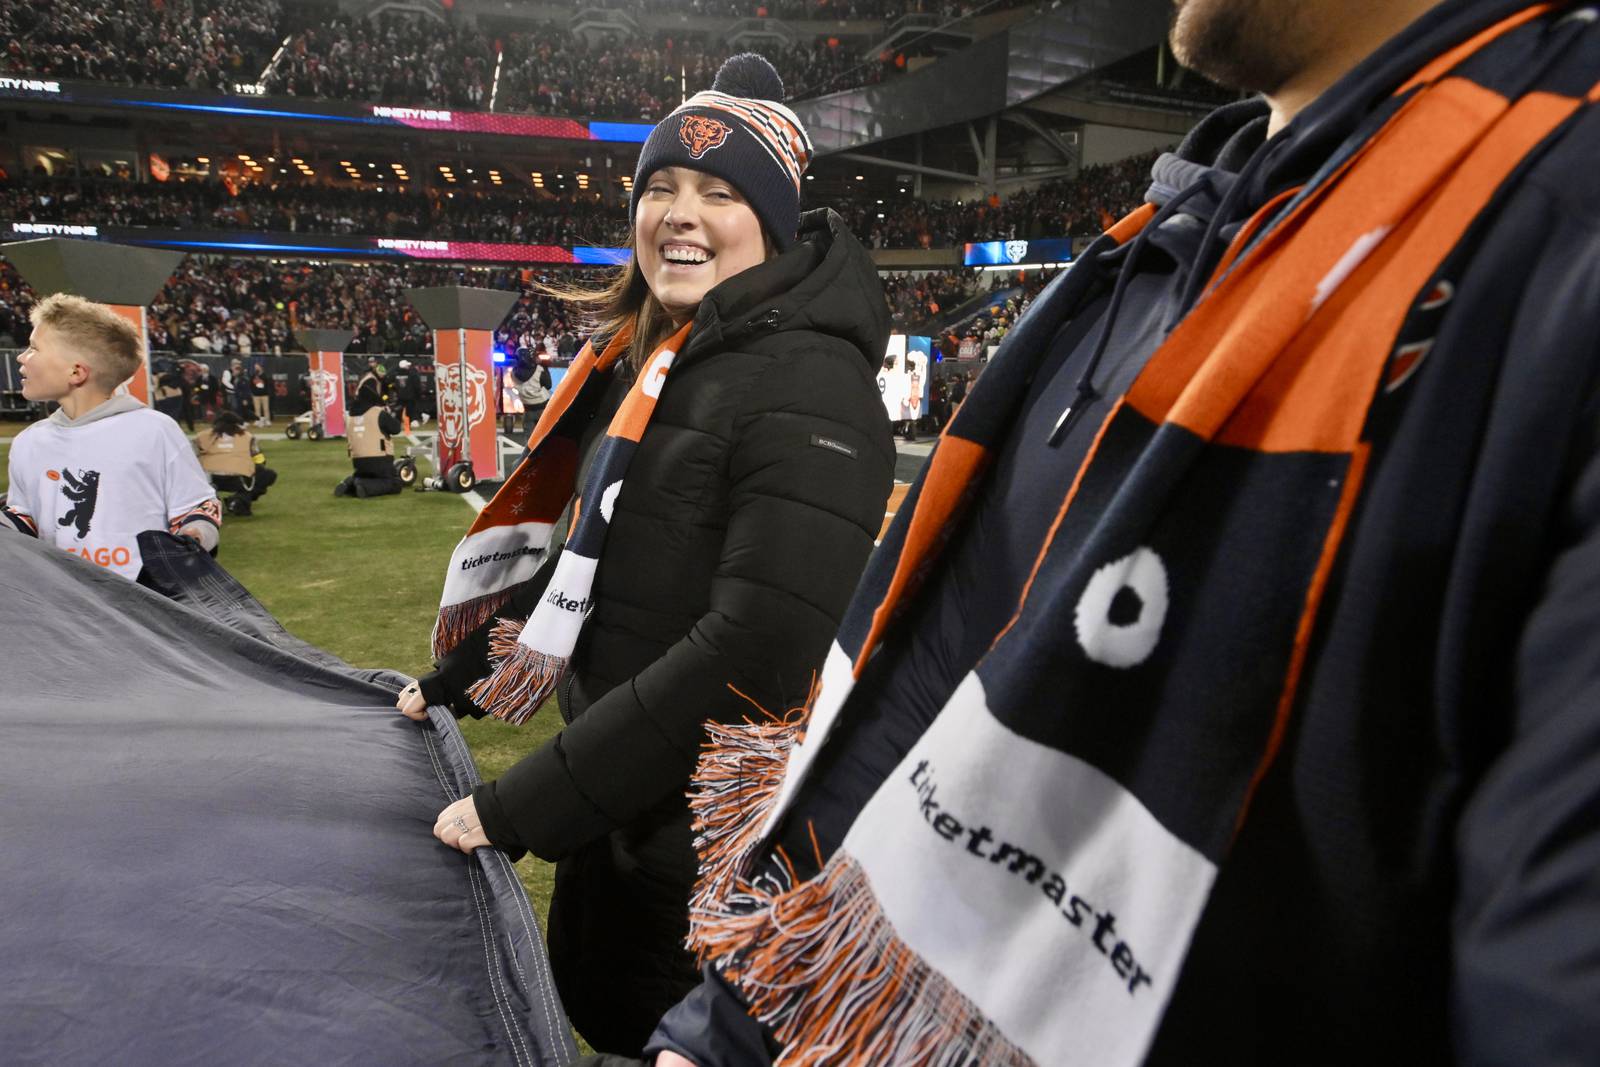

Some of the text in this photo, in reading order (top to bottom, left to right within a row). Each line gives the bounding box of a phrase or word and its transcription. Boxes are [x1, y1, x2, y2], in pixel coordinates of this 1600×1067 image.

[22, 79, 60, 92] NINE
[373, 106, 452, 122] NINETY NINE
[12, 223, 98, 236] NINETY NINE
[377, 239, 449, 250] NINETY NINE
[66, 546, 130, 568] AGO
[462, 546, 545, 570] ticketmaster
